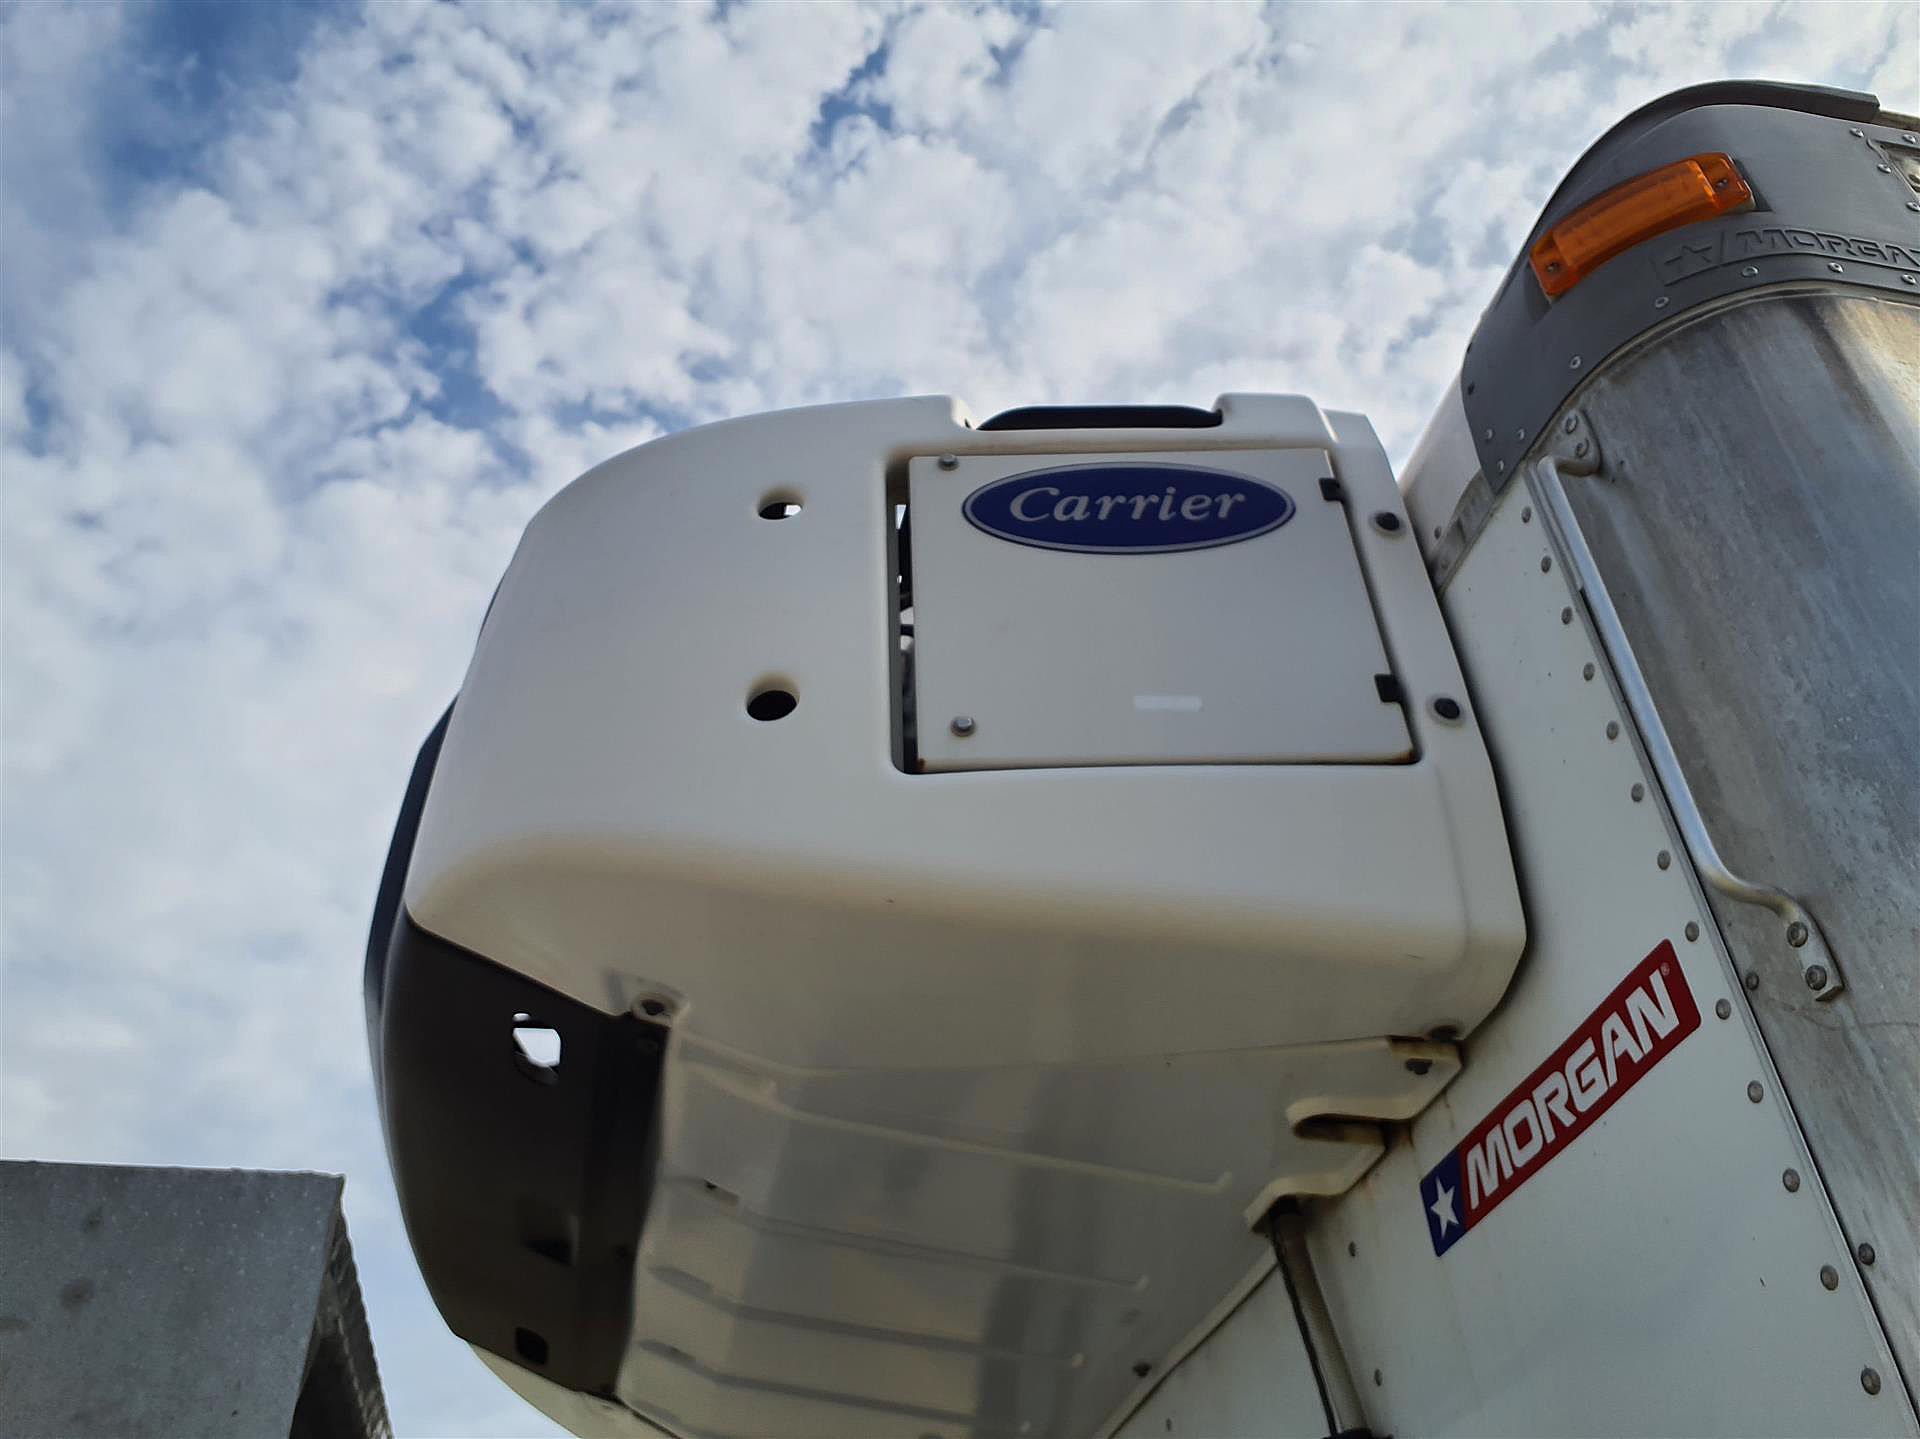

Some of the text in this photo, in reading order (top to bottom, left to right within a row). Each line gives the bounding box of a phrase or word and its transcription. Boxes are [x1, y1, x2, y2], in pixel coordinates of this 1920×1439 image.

[1735, 228, 1920, 267] MORGA
[1010, 487, 1245, 521] Carrier
[1466, 968, 1680, 1209] MORGAN
